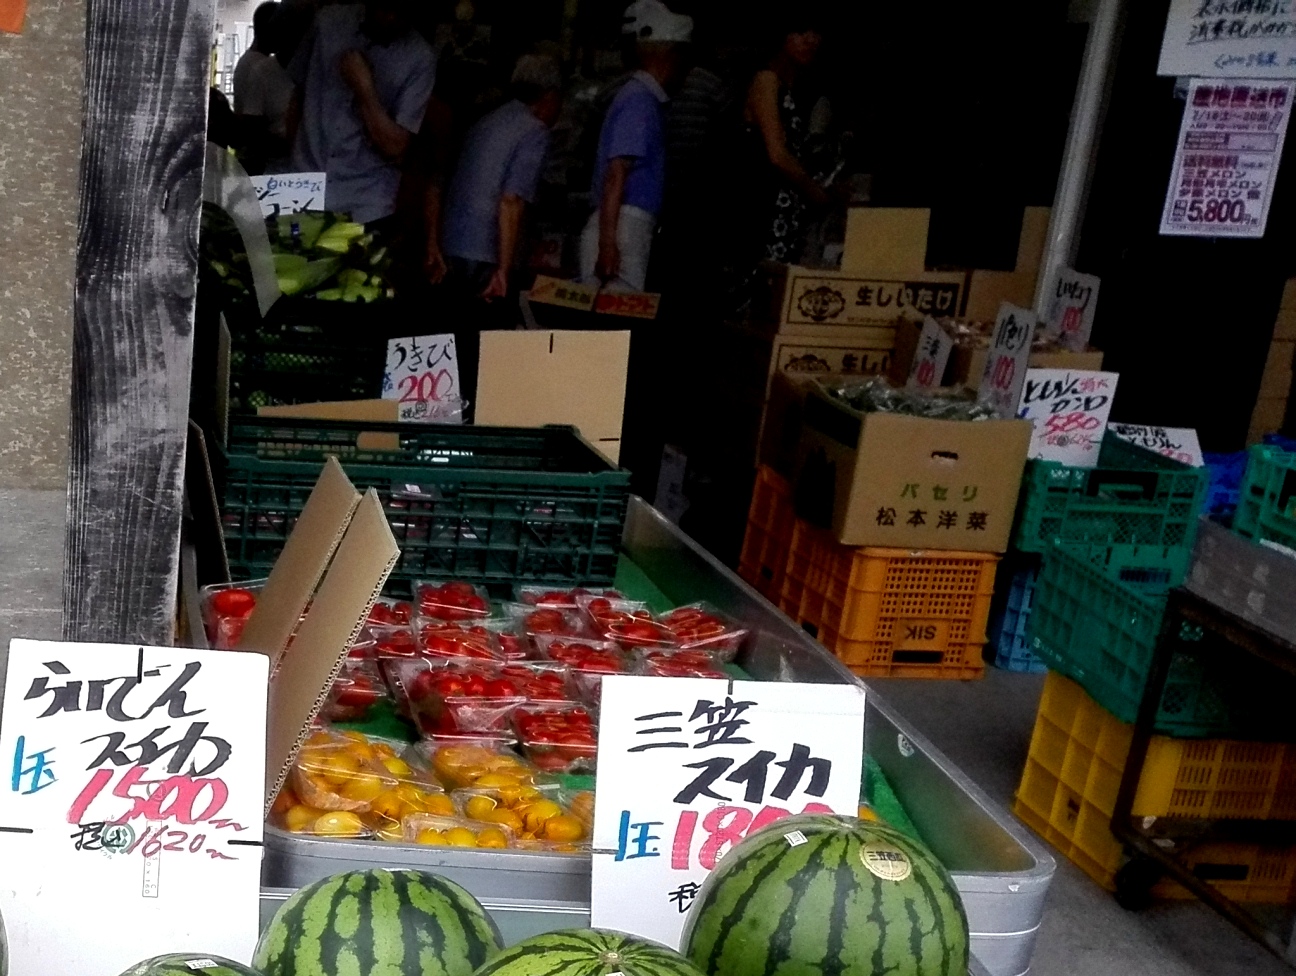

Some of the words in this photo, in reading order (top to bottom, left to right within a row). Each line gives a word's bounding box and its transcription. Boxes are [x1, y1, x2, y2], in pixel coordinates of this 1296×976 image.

[855, 286, 954, 309] 生しいたけ
[397, 369, 454, 403] 200
[875, 506, 989, 531] 松本洋菜
[905, 625, 937, 640] SIK
[627, 697, 759, 752] 三笠
[80, 722, 232, 777] スイカ
[673, 743, 832, 804] スイカ
